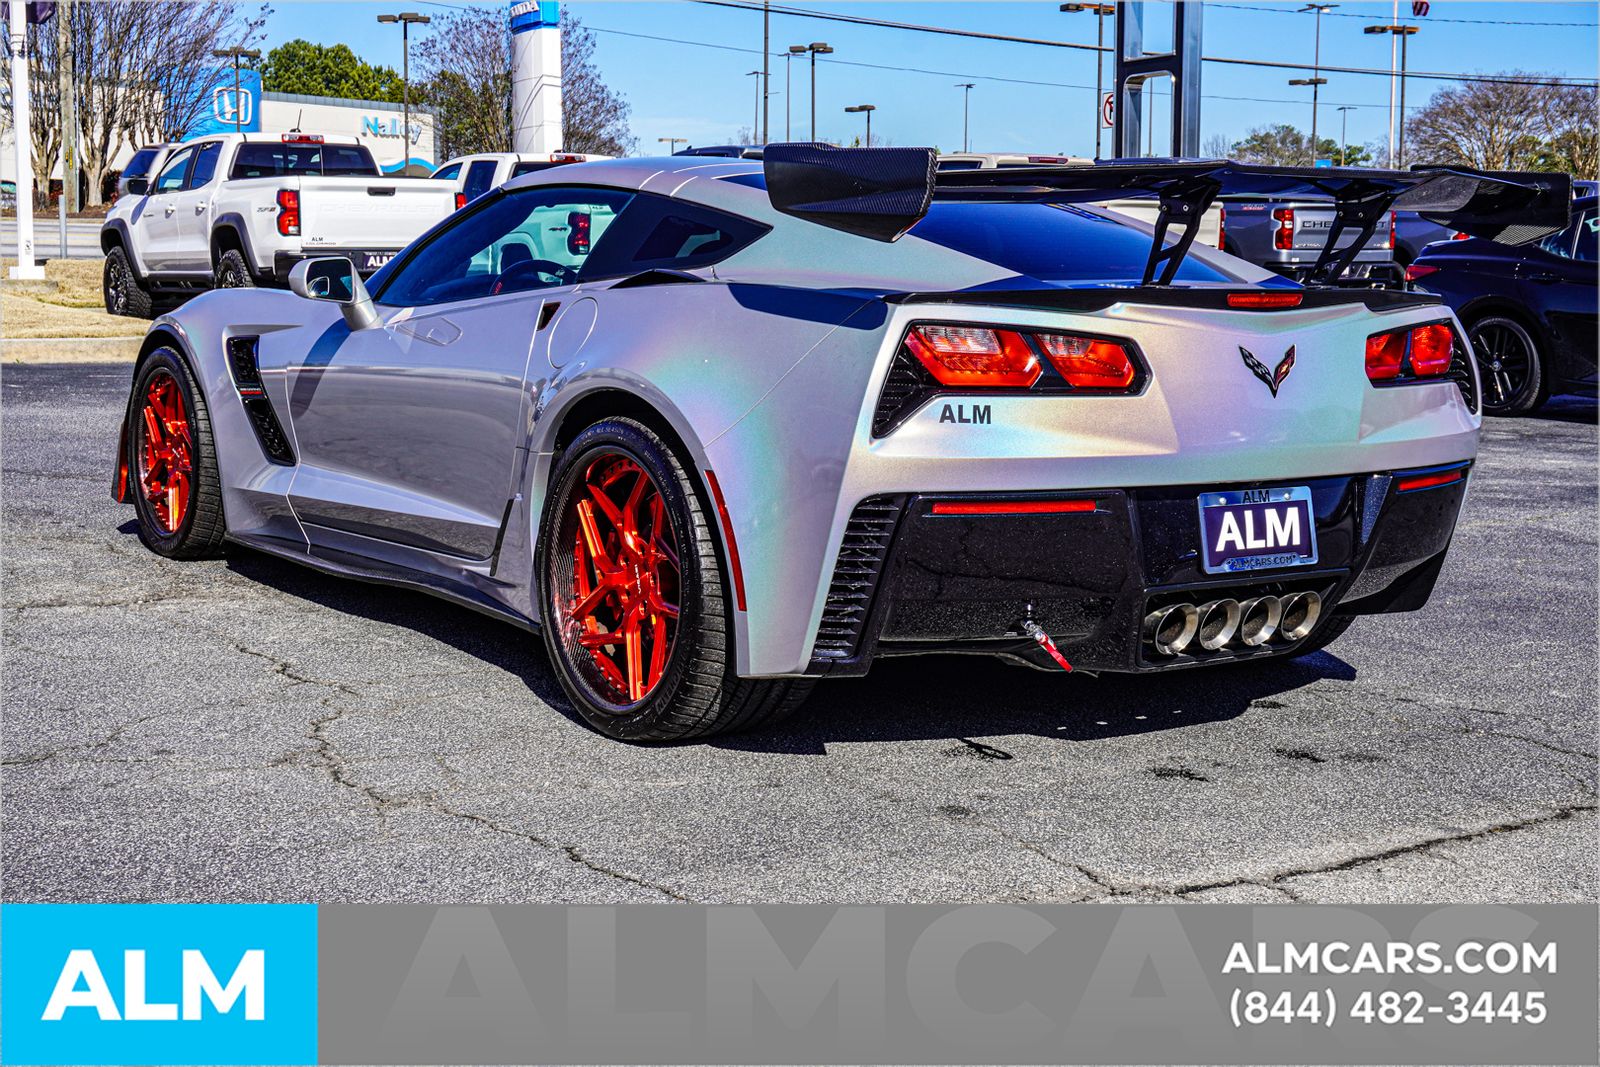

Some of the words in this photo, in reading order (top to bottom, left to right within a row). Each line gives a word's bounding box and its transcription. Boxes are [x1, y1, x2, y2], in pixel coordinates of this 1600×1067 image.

[938, 403, 992, 425] ALM
[1242, 489, 1271, 504] ALM
[1215, 506, 1301, 552] ALM
